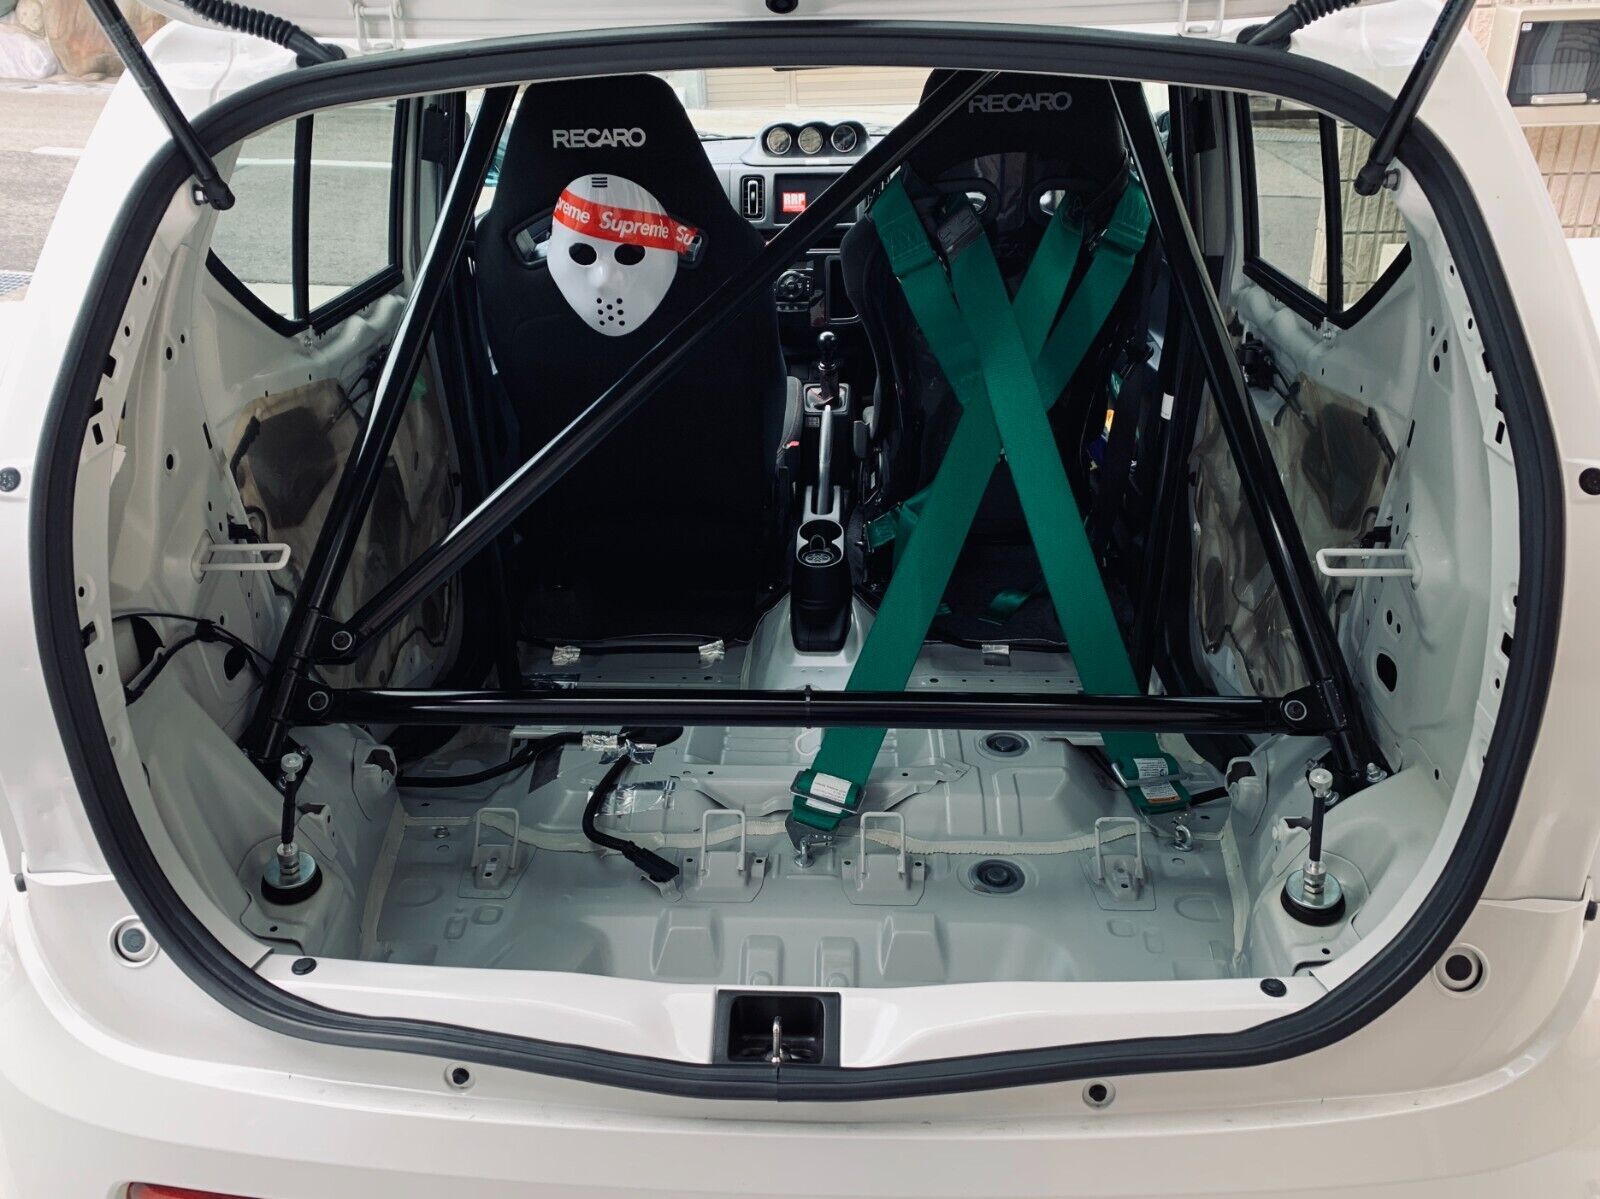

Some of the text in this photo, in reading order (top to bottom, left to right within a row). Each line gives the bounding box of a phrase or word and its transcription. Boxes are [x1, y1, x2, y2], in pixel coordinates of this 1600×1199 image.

[968, 91, 1073, 113] RECARO
[552, 127, 647, 149] RECARO
[599, 211, 669, 239] Supreme
